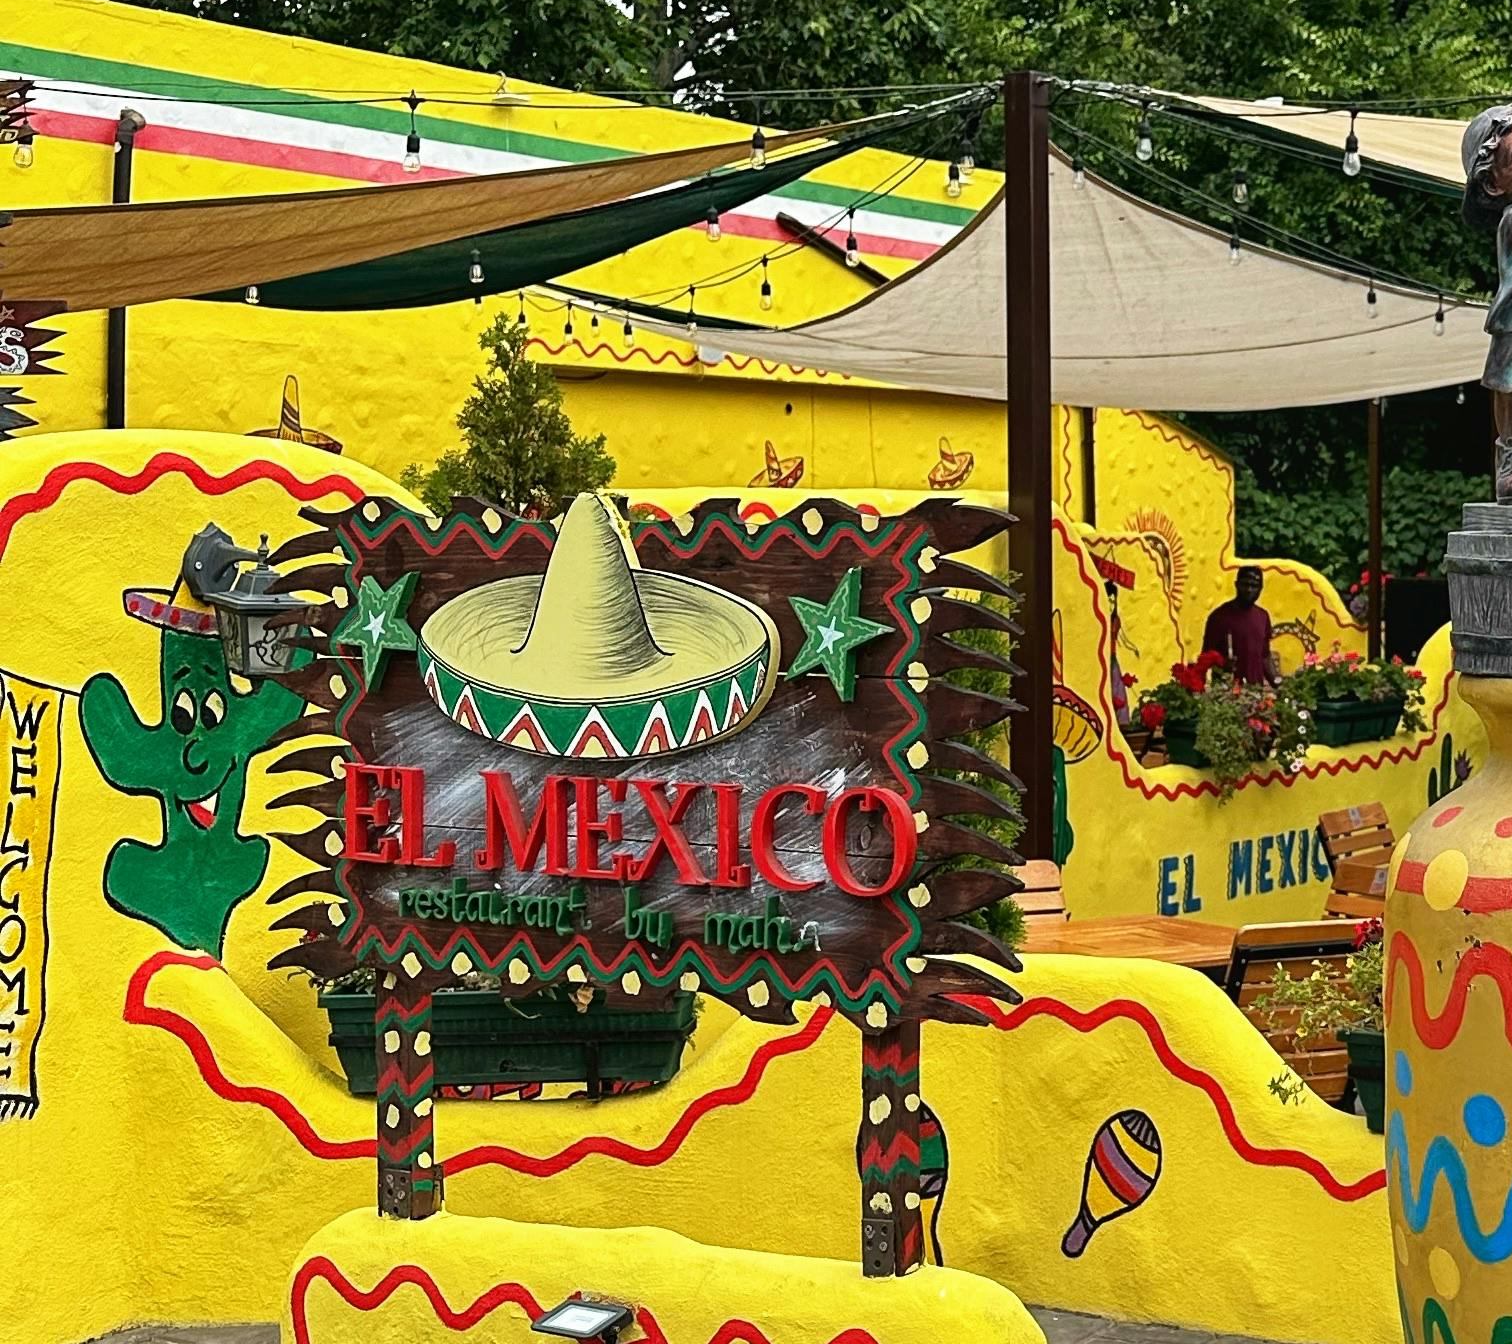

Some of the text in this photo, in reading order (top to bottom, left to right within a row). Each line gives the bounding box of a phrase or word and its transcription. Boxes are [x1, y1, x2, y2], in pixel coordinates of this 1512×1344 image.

[342, 762, 919, 898] EL MEXICO
[1157, 824, 1330, 917] EL MEXIC
[398, 877, 593, 937] restaurant
